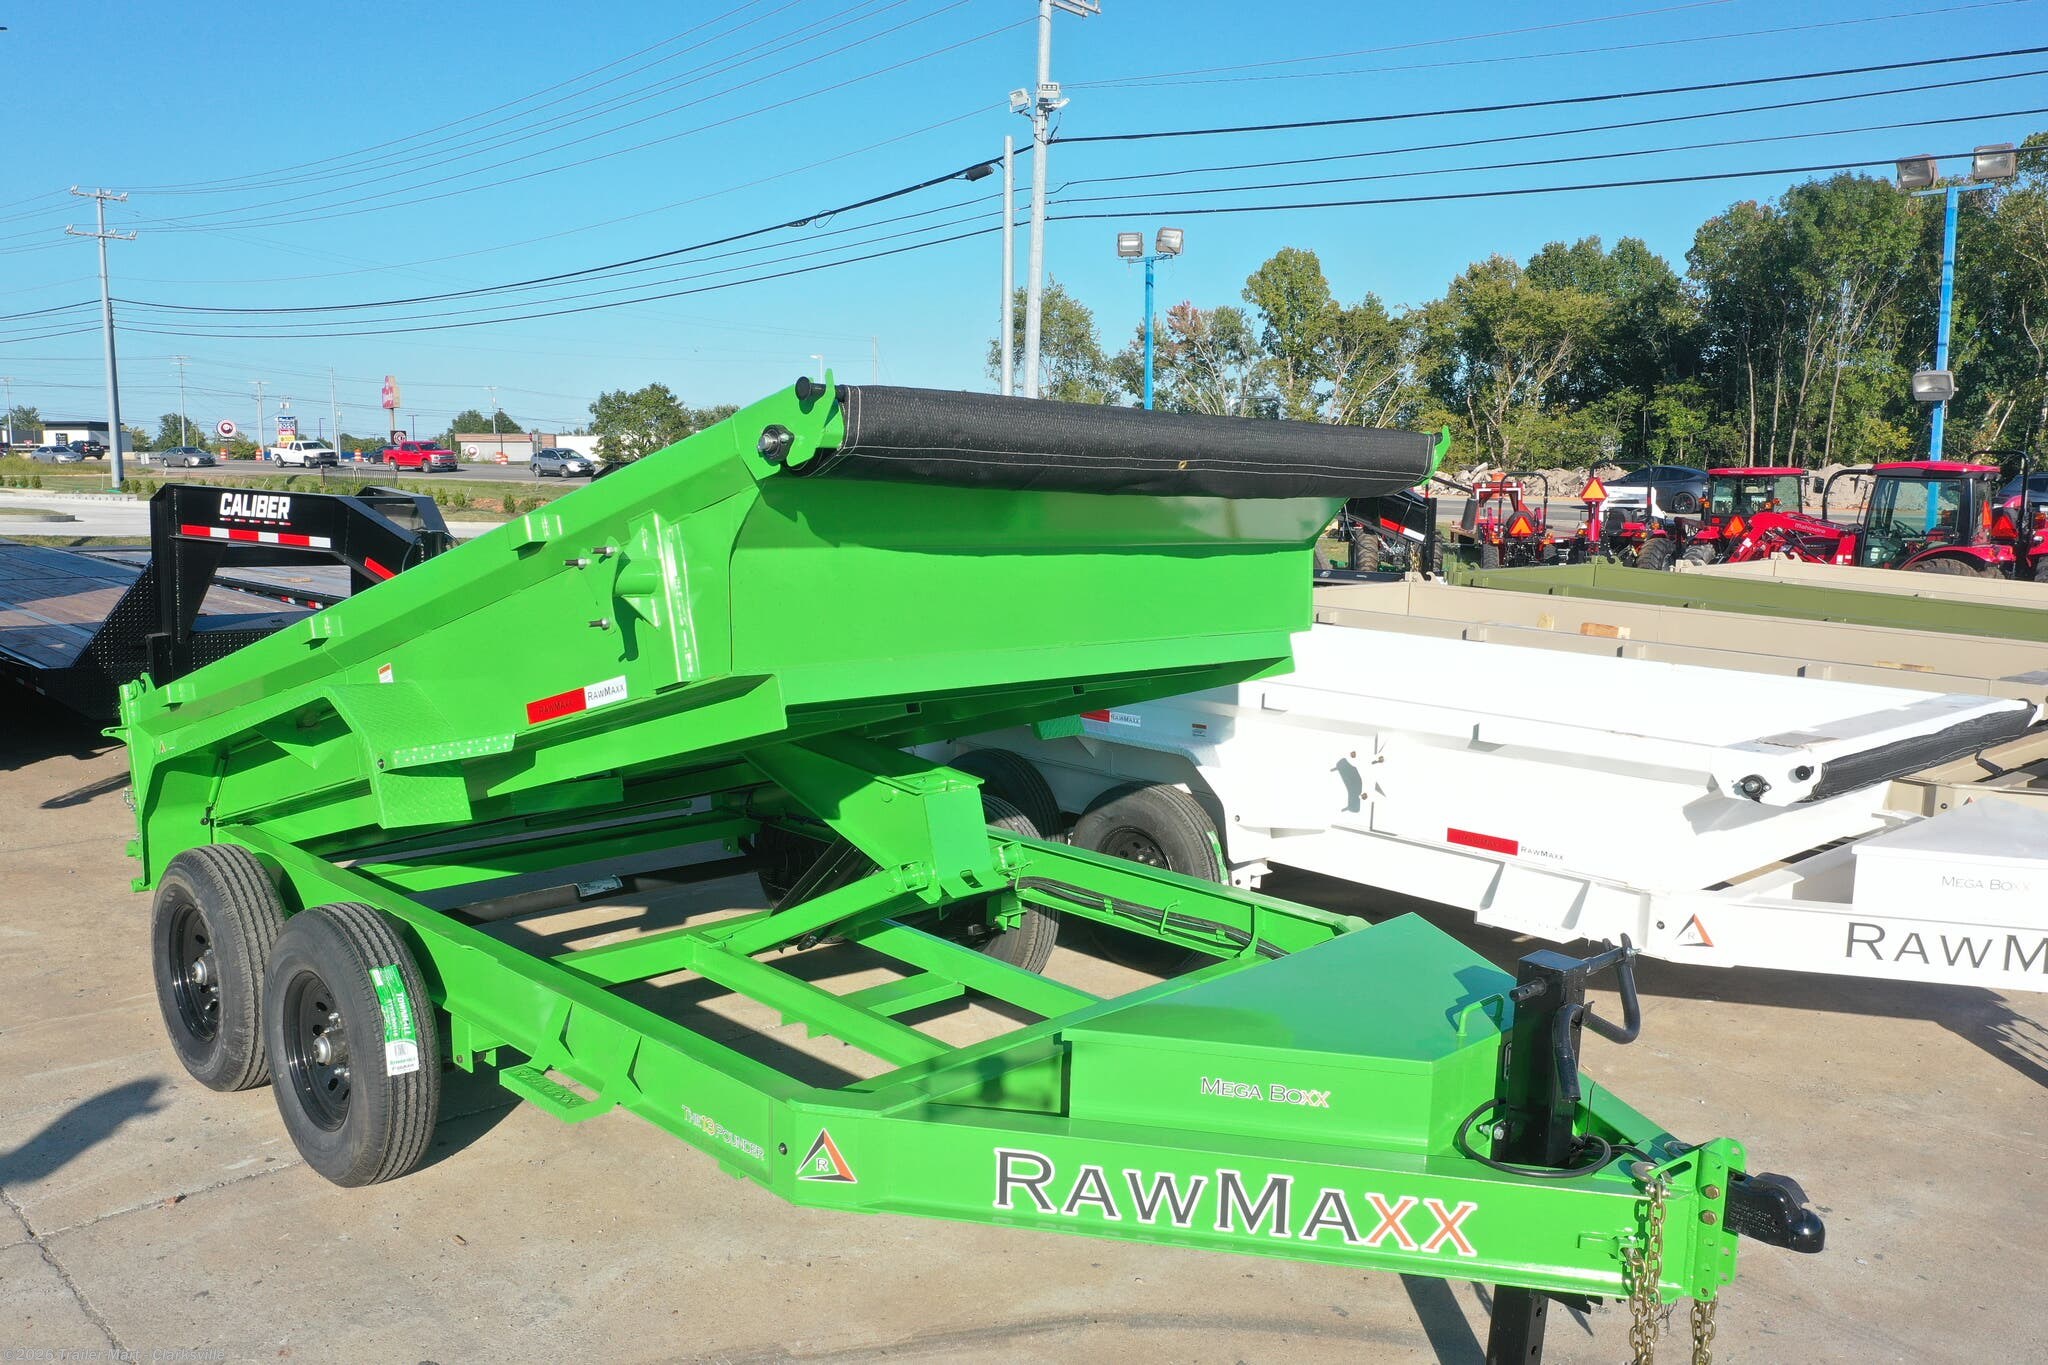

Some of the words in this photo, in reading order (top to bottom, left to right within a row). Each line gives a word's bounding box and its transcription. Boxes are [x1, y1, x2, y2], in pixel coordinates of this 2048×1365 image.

[219, 492, 291, 520] CALIBER
[1941, 875, 1984, 889] MEGA
[1200, 1076, 1263, 1100] MEGA
[1269, 1084, 1331, 1108] BOXX
[815, 1157, 830, 1172] R
[993, 1147, 1477, 1257] RAWMAXX
